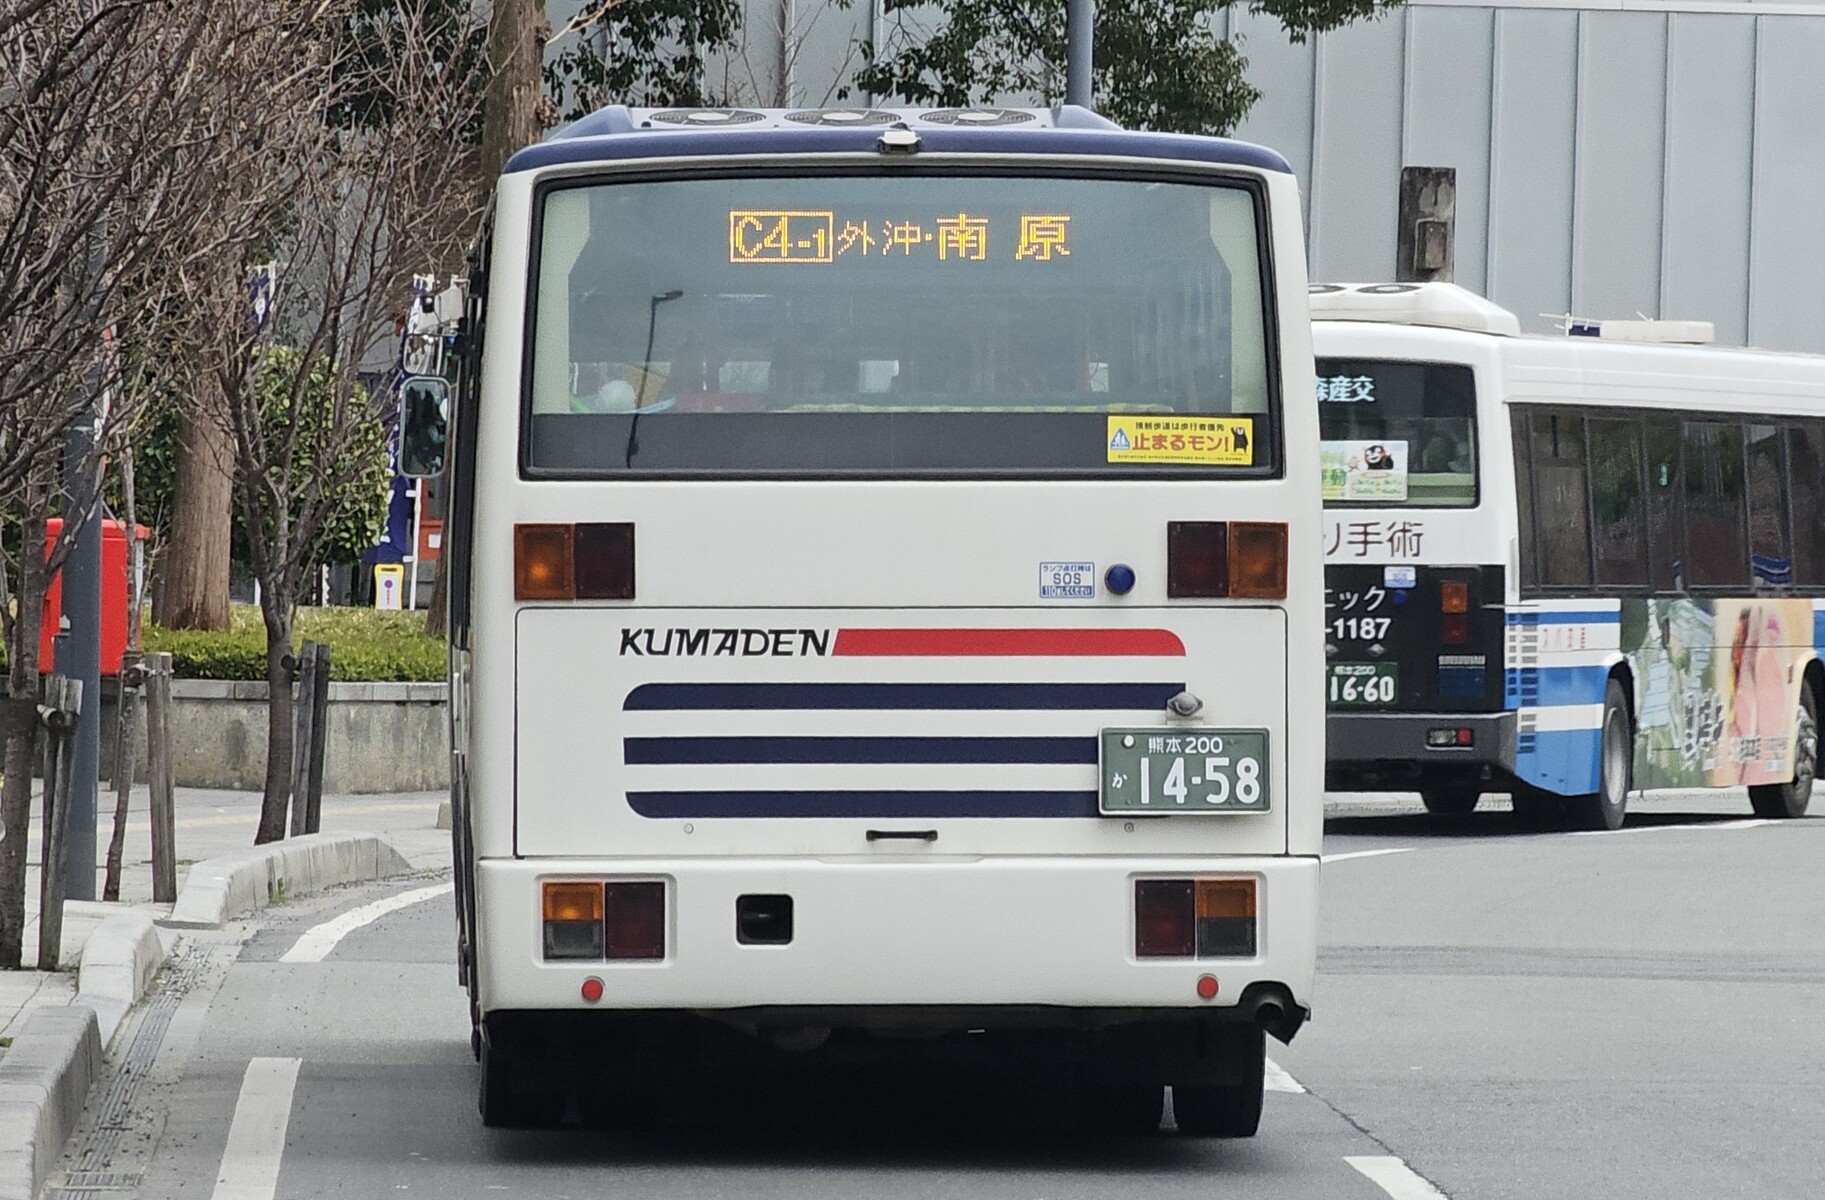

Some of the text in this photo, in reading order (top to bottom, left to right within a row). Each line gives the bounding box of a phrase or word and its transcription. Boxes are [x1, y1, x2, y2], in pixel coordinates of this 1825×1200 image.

[736, 215, 825, 257] C4-1
[1132, 433, 1229, 452] 止まるモン!
[1053, 573, 1082, 585] SOS
[619, 628, 830, 656] KUMADEN
[1140, 757, 1261, 804] 14-58
